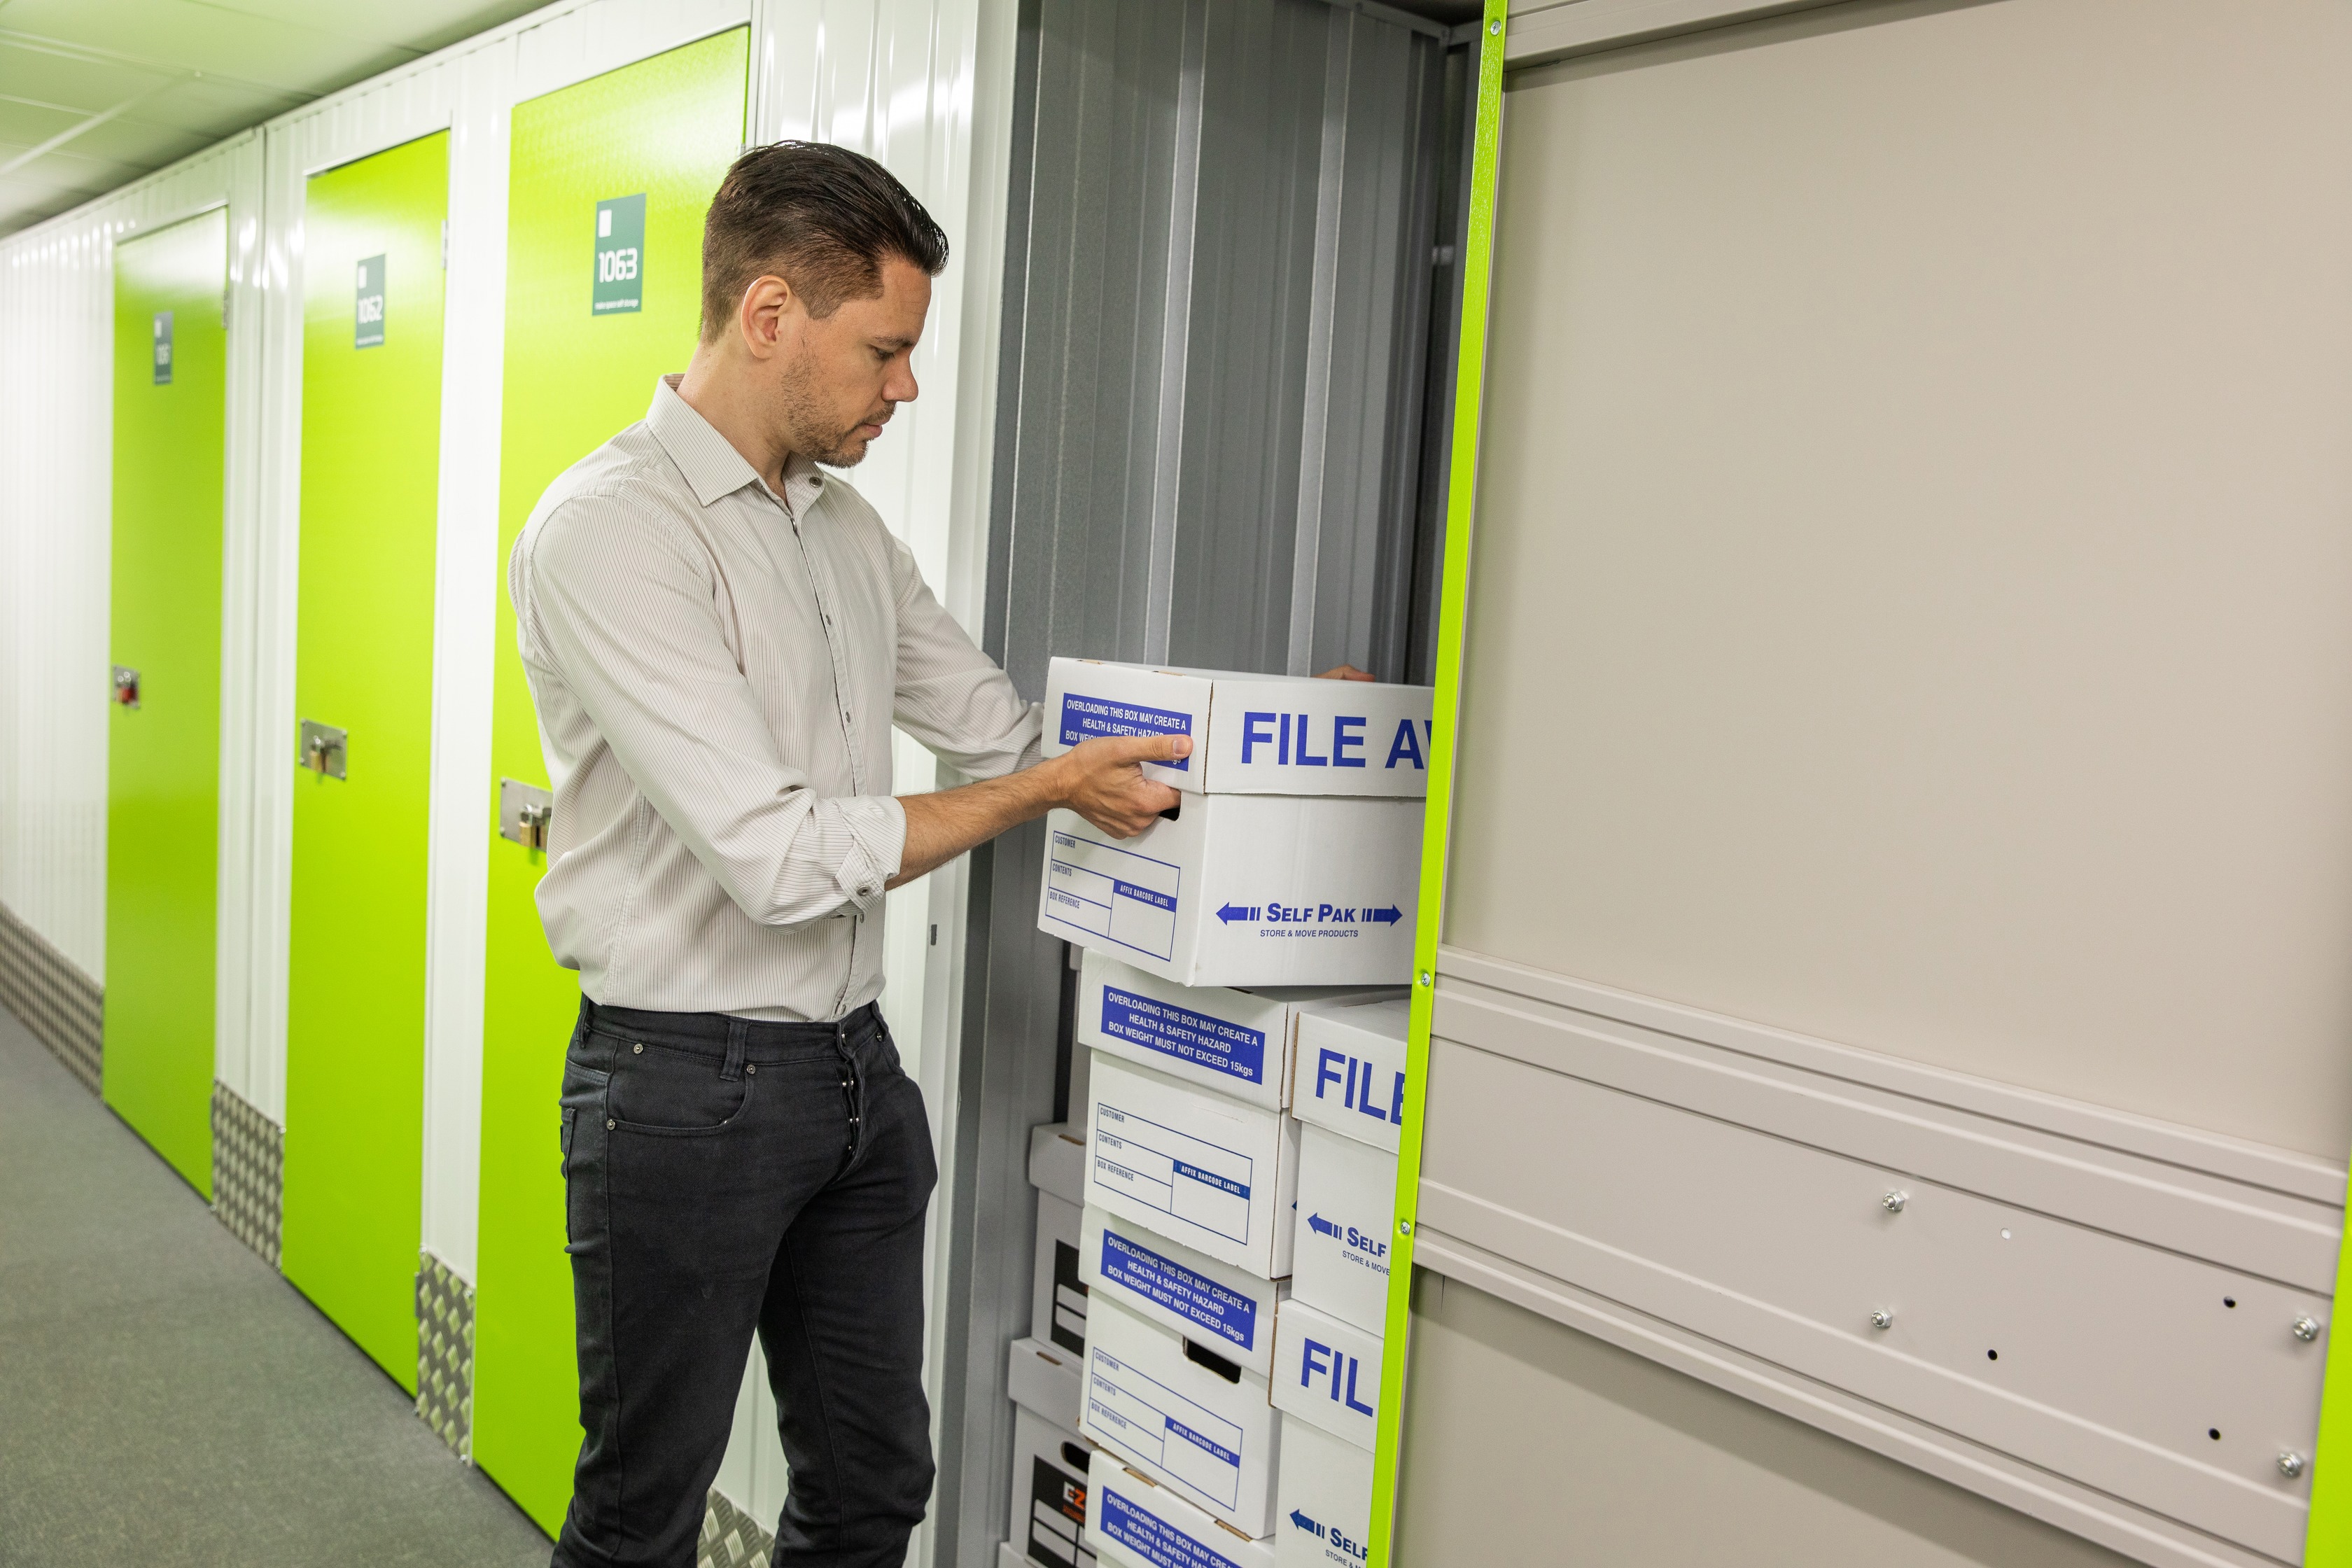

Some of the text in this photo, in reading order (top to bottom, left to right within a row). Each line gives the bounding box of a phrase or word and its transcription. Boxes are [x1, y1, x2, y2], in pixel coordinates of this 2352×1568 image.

[598, 247, 638, 283] 1063
[358, 294, 384, 324] 1062
[1067, 699, 1186, 730] OVERLOADING THIS BOX MAY CREATE A
[1082, 718, 1105, 731] HEALTH
[1106, 722, 1111, 732] &
[1112, 725, 1136, 736] SAFETY
[1065, 729, 1078, 741] BOX
[1241, 712, 1432, 769] FILE A
[1055, 835, 1075, 848] CUSTOMER
[1053, 863, 1072, 876] CONTENTS
[1058, 893, 1079, 909] REFERENCE
[1120, 885, 1169, 907] AFFIX BARCODE LABEL
[1108, 992, 1257, 1046] OVERLOADING THIS BOX MAY CREATE A
[1128, 1013, 1231, 1053] HEALTH & SAFETY HAZARD
[1108, 1021, 1252, 1077] BOX WEIGHT MUST NOT EXCEED 15kgs
[1100, 1107, 1124, 1123] CUSTOMER
[1099, 1133, 1122, 1149] CONTENTS
[1098, 1161, 1134, 1182] BOX REFERENCE
[1181, 1165, 1240, 1194] AFFIX BARCODE LABEL
[1107, 1236, 1250, 1313] OVERLOADING THIS BOX MAY CREATE A
[1343, 1250, 1364, 1266] STORE
[1372, 1263, 1390, 1275] MOVE
[1127, 1260, 1224, 1315] HEALTH & SAFETY HAZARD
[1107, 1264, 1244, 1341] BOX WEIGHT MUST NOT EXCEED 15kgs
[1096, 1352, 1119, 1371] CUSTOMER
[1093, 1376, 1116, 1396] CONTENTS
[1091, 1401, 1127, 1429] BOX REFERENCE
[1172, 1422, 1230, 1461] AFFIX BARCODE LABEL
[1107, 1494, 1157, 1530] OVERLOADING
[1158, 1523, 1175, 1541] THIS
[1175, 1534, 1191, 1551] BOX
[1192, 1545, 1209, 1561] MAY
[1126, 1520, 1154, 1543] HEALTH
[1155, 1537, 1161, 1547] &
[1162, 1541, 1190, 1564] SAFETY
[1107, 1521, 1122, 1537] BOX
[1123, 1532, 1150, 1554] WEIGHT
[1151, 1548, 1172, 1567] MUST
[1326, 1550, 1347, 1566] STORE
